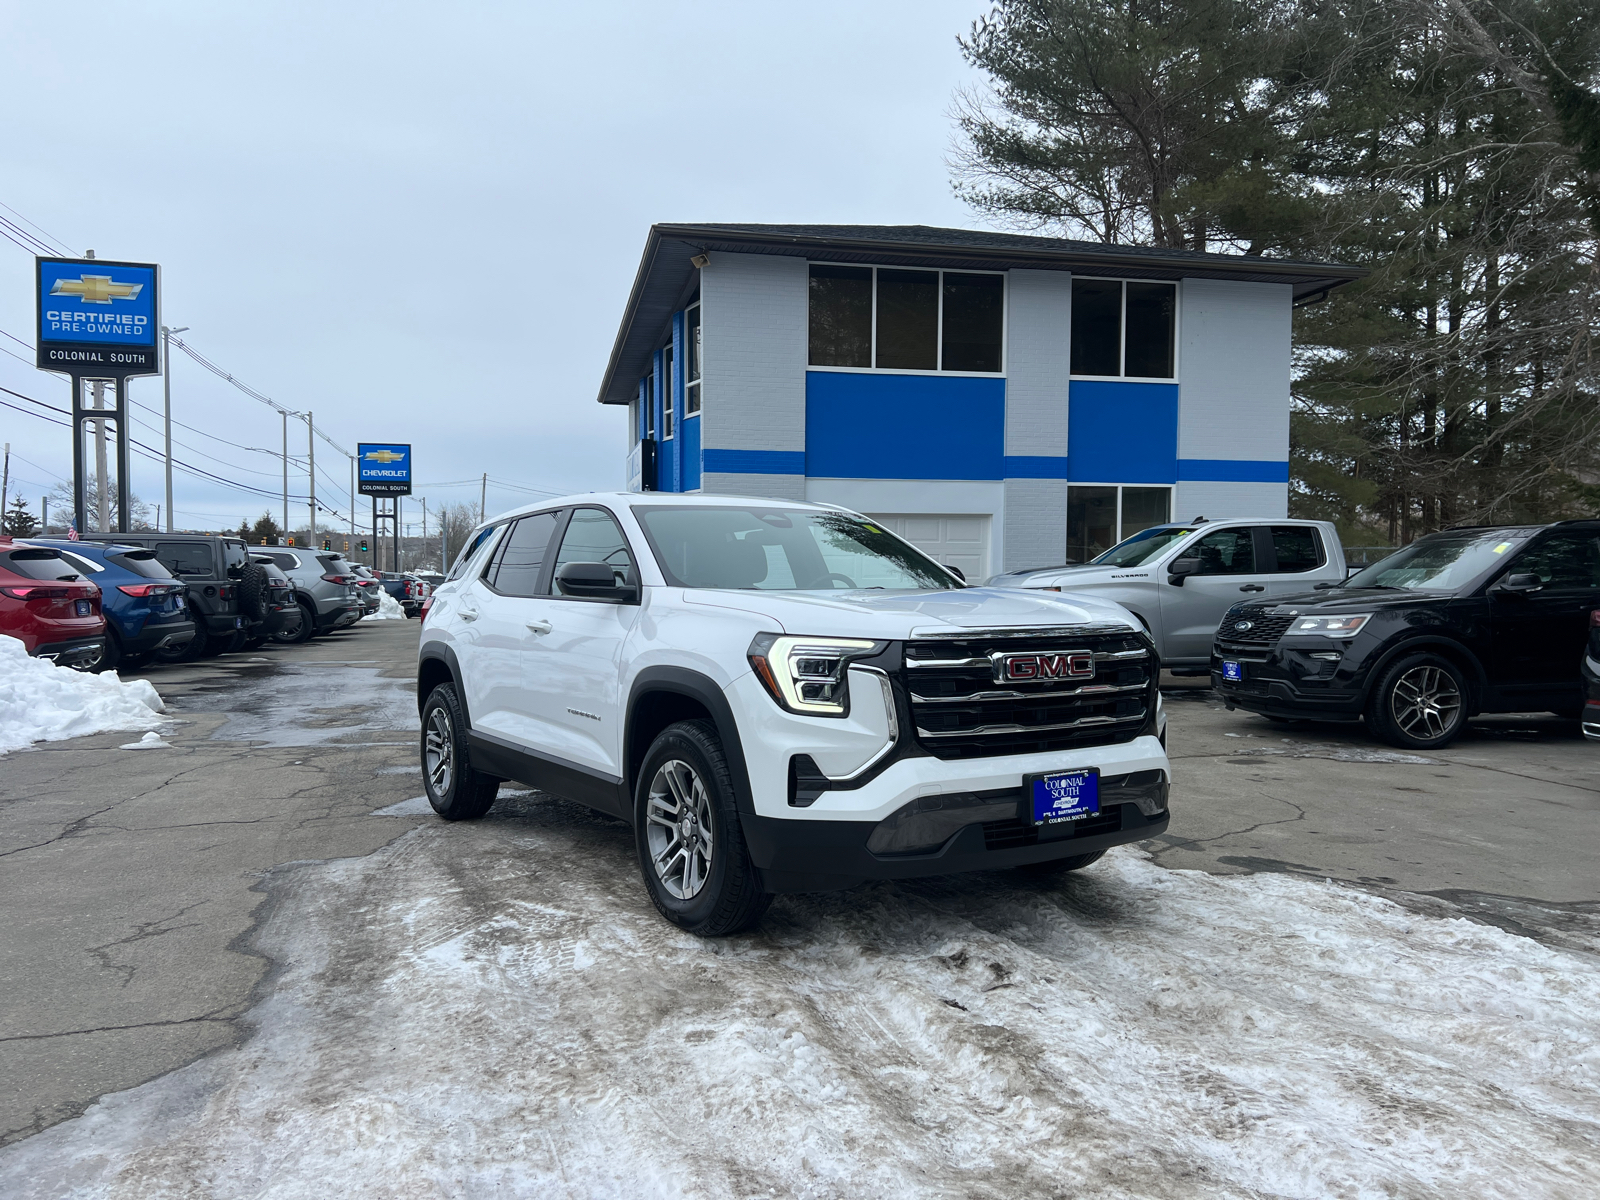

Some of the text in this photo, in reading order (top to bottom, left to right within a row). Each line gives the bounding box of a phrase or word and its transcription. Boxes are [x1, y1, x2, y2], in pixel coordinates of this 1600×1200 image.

[46, 310, 148, 325] CERTIFIED
[51, 321, 143, 335] PRE-OWNED
[49, 350, 145, 363] COLONIAL SOUTH
[362, 469, 407, 477] CHEVROLET
[1006, 655, 1093, 679] GMC
[1045, 777, 1085, 790] COLONIAL
[1051, 786, 1079, 798] SOUTH
